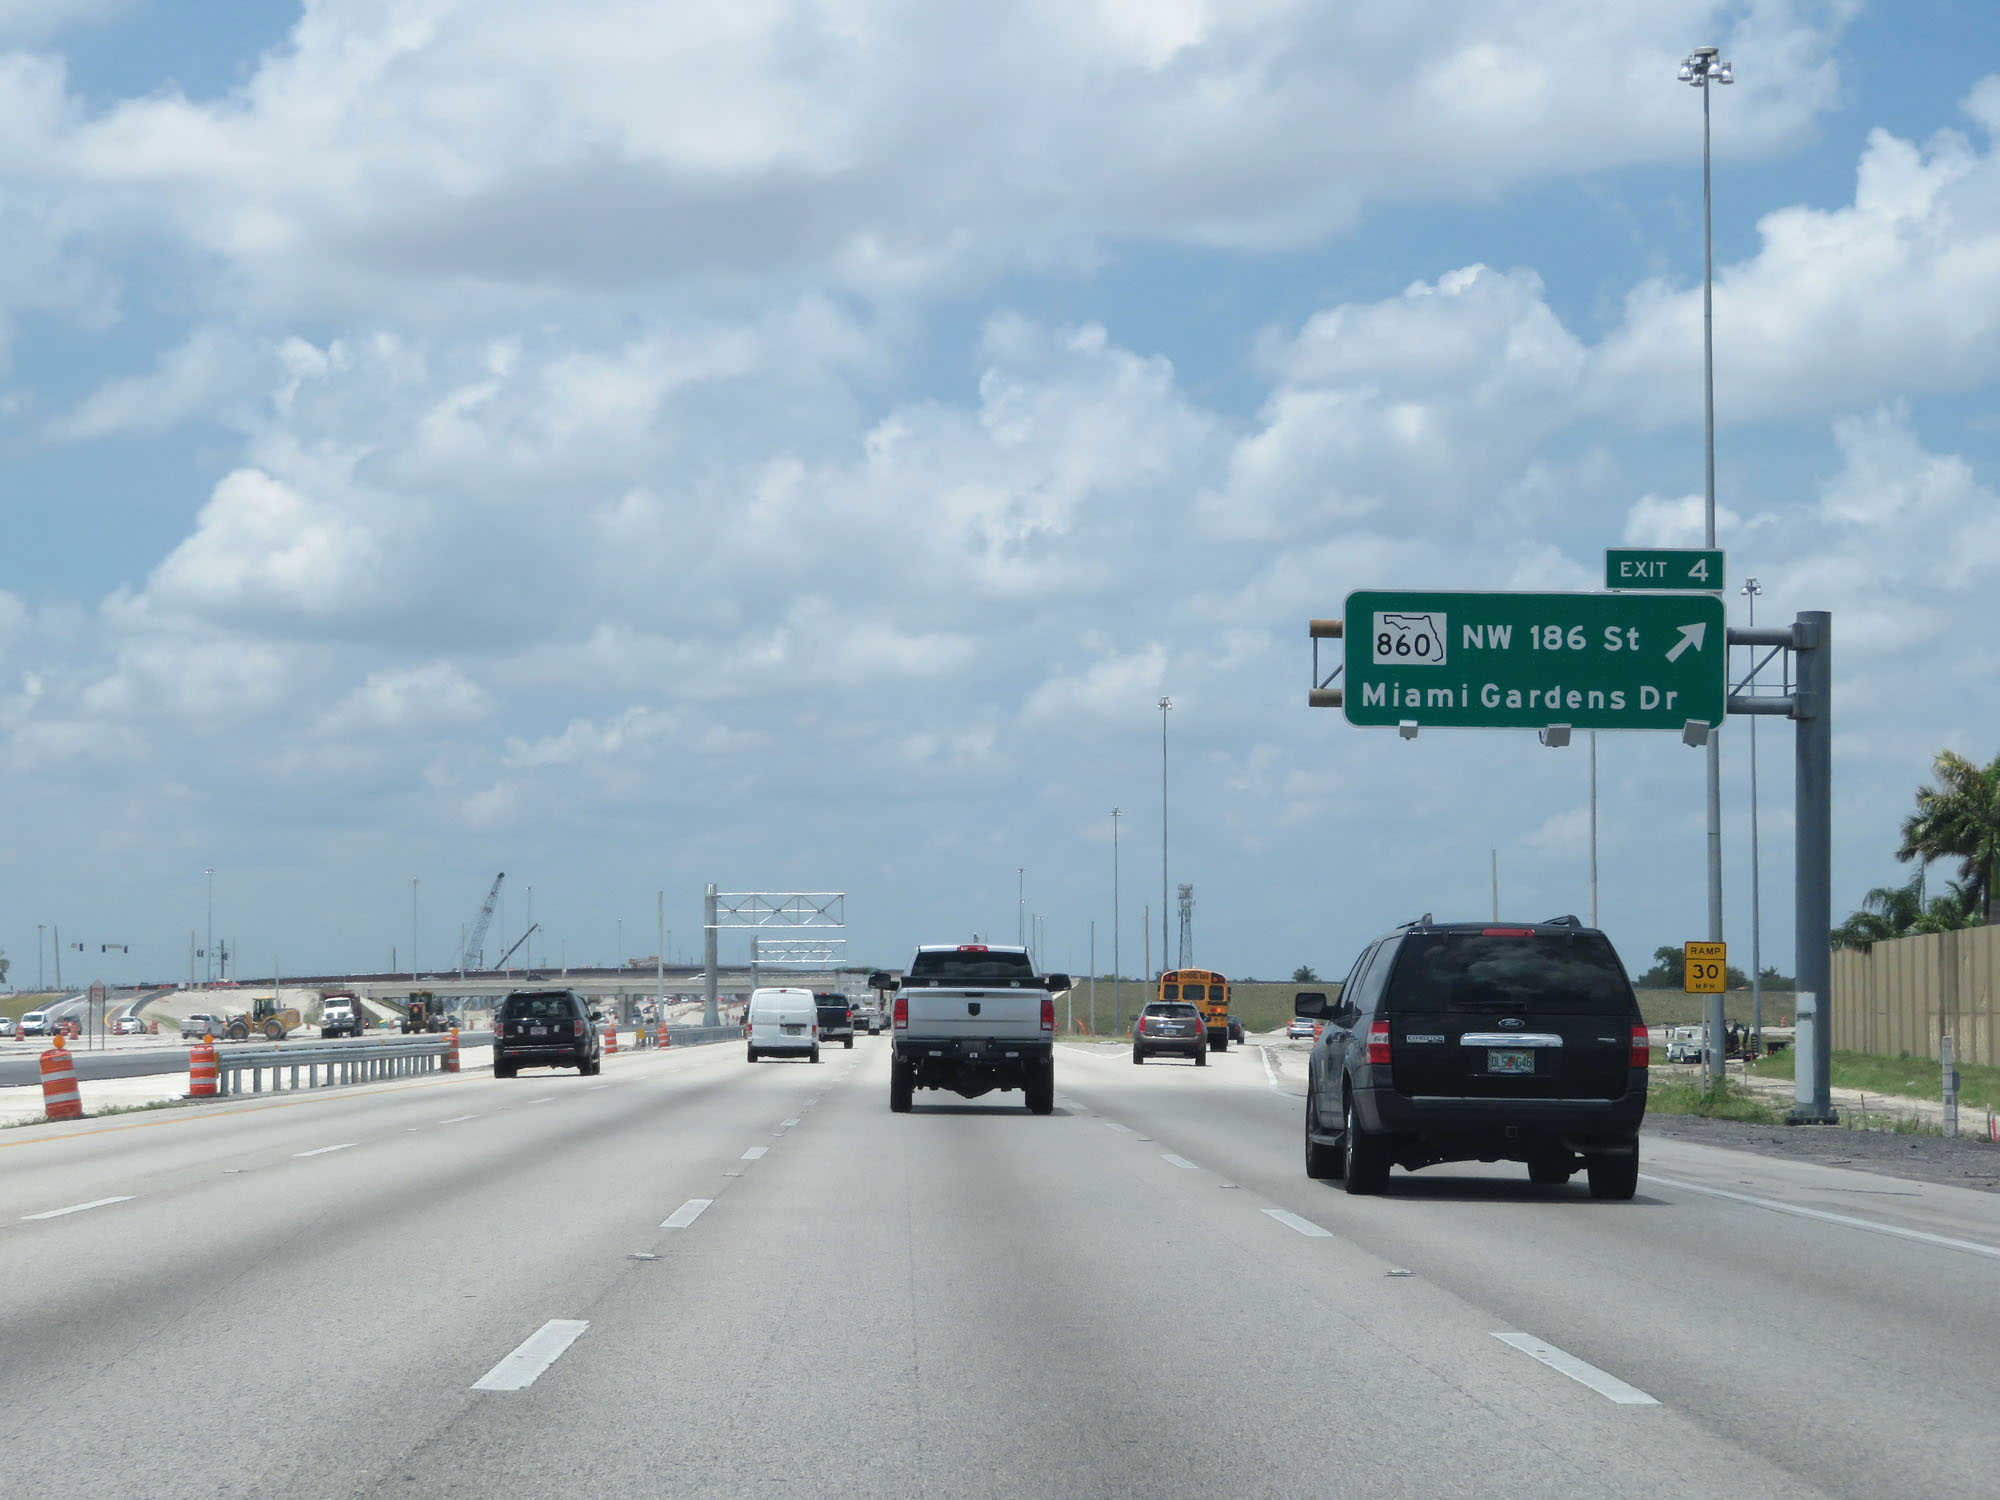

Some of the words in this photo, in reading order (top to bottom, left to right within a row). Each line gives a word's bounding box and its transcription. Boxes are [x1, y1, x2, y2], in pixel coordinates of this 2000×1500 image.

[1620, 560, 1667, 578] EXIT
[1688, 559, 1709, 582] 4
[1376, 632, 1431, 657] 860
[1463, 624, 1512, 650] NW
[1530, 625, 1587, 651] 186
[1603, 626, 1640, 652] St
[1362, 682, 1468, 708] Miami
[1481, 683, 1626, 711] Gardens
[1640, 686, 1678, 711] Dr
[1690, 947, 1721, 955] RAMP
[1692, 964, 1719, 979] 30
